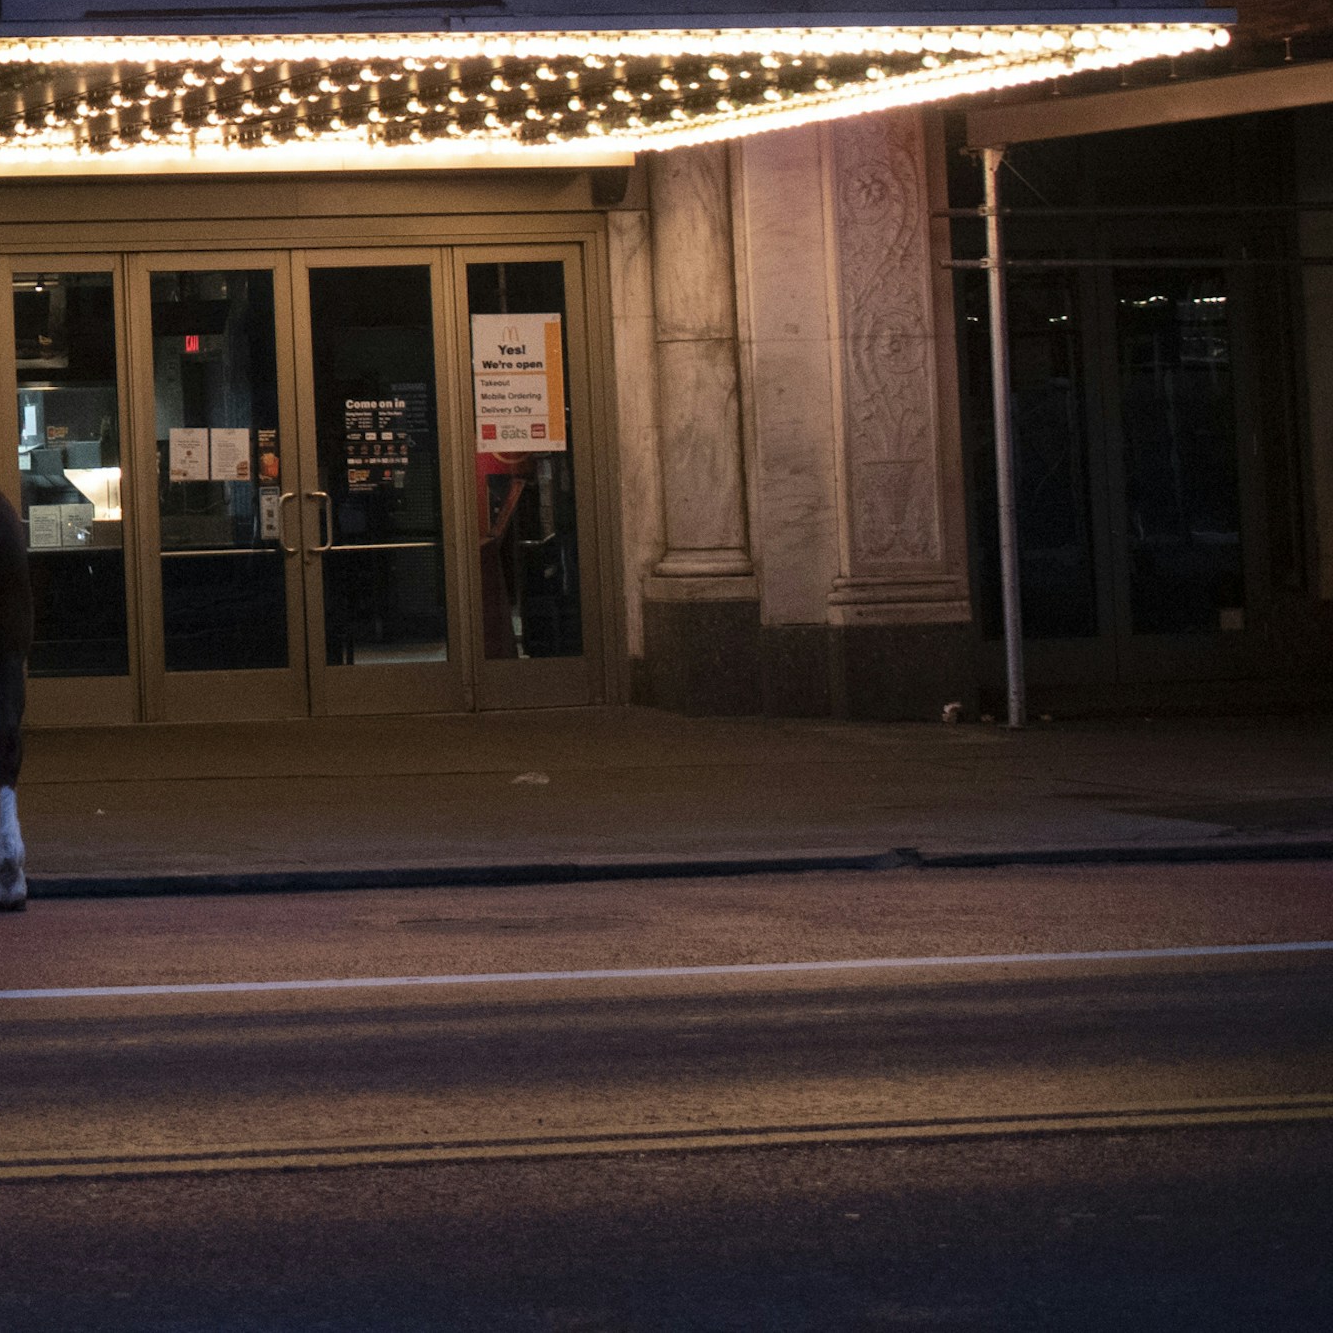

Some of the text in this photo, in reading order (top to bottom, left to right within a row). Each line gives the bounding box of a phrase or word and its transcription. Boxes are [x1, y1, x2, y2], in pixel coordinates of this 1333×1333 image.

[498, 345, 526, 355] Yes!
[482, 360, 543, 371] We're open
[481, 379, 511, 387] Takeout
[508, 392, 542, 401] Ordering
[345, 398, 406, 409] Come on in
[481, 406, 532, 414] Delivery Only
[501, 428, 528, 439] eats
